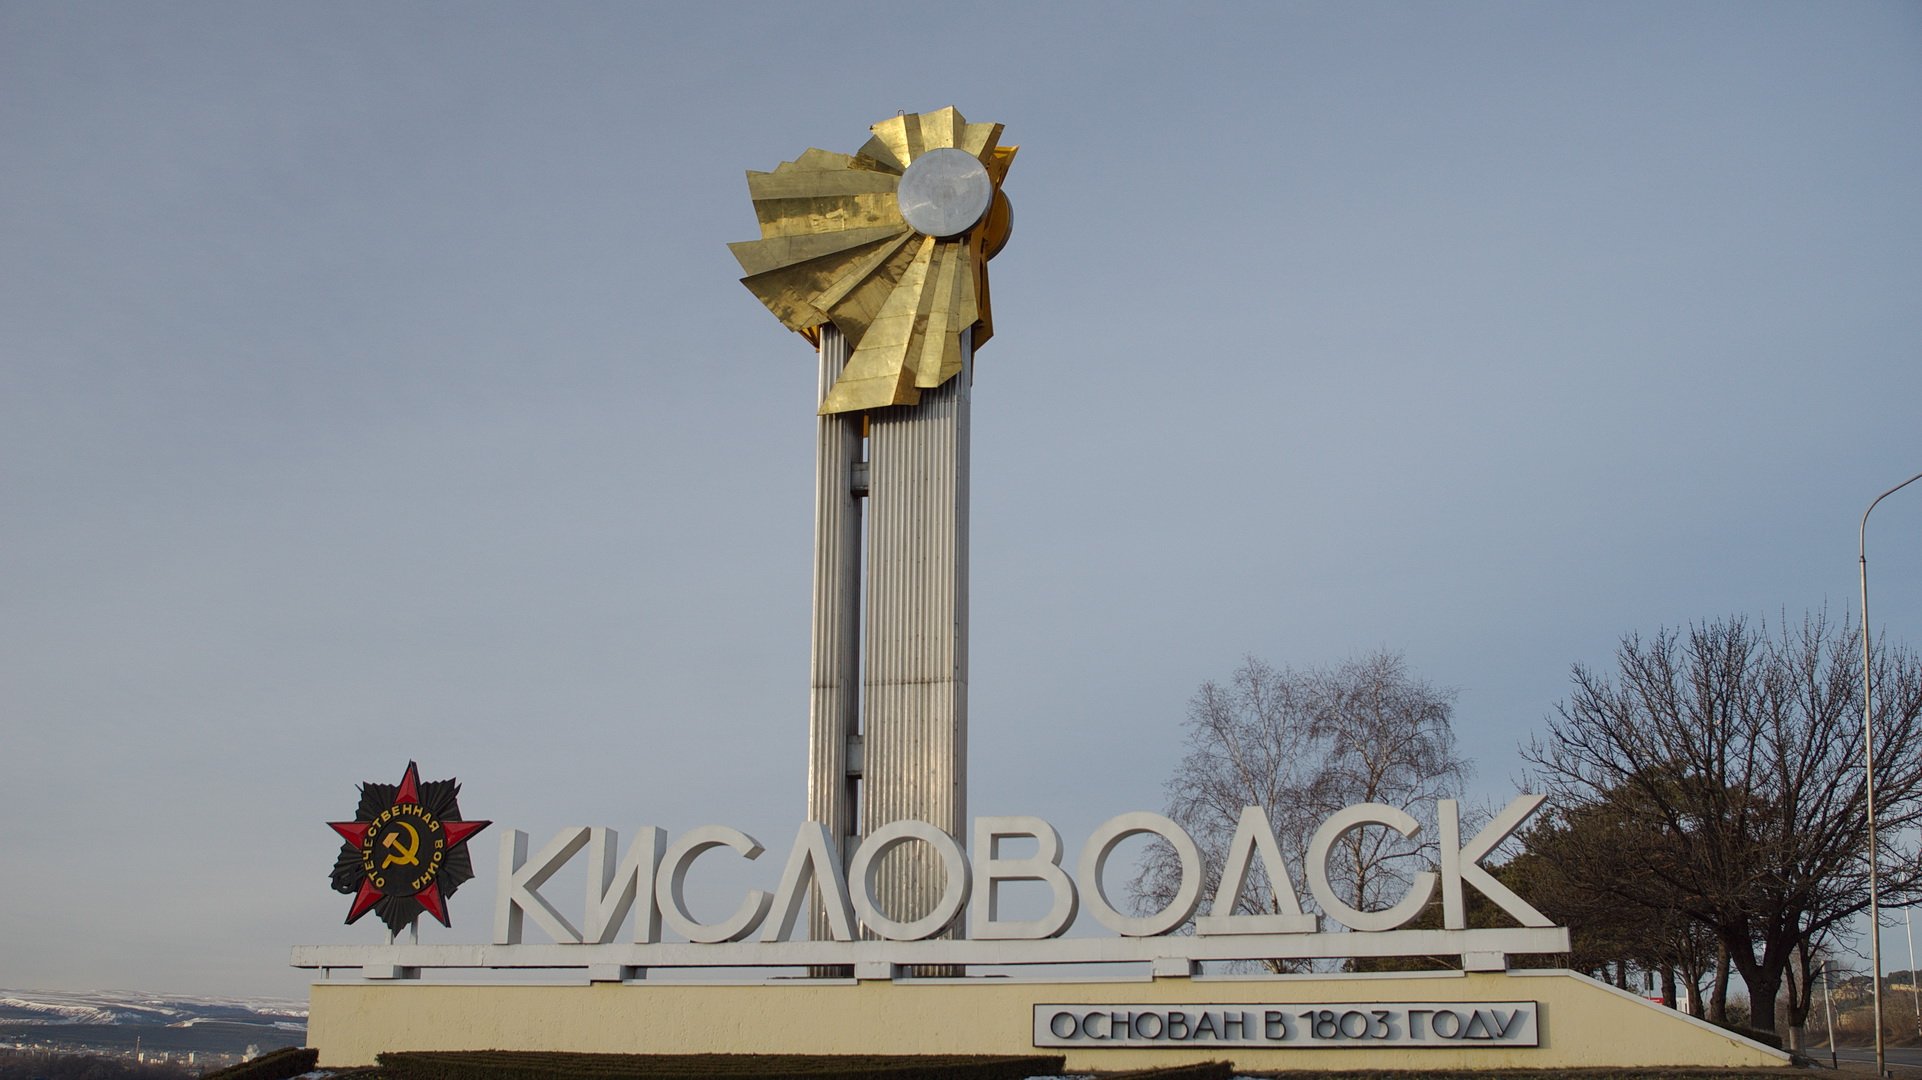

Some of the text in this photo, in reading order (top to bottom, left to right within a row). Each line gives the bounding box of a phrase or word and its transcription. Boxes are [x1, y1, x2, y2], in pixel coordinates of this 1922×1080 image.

[363, 804, 440, 888] ОТЕЧЕСТВЕННАЯ
[494, 794, 1557, 944] КИСЛОВОДСК
[1050, 1009, 1519, 1040] ОСНОВАН В 1803 ГОДУ
